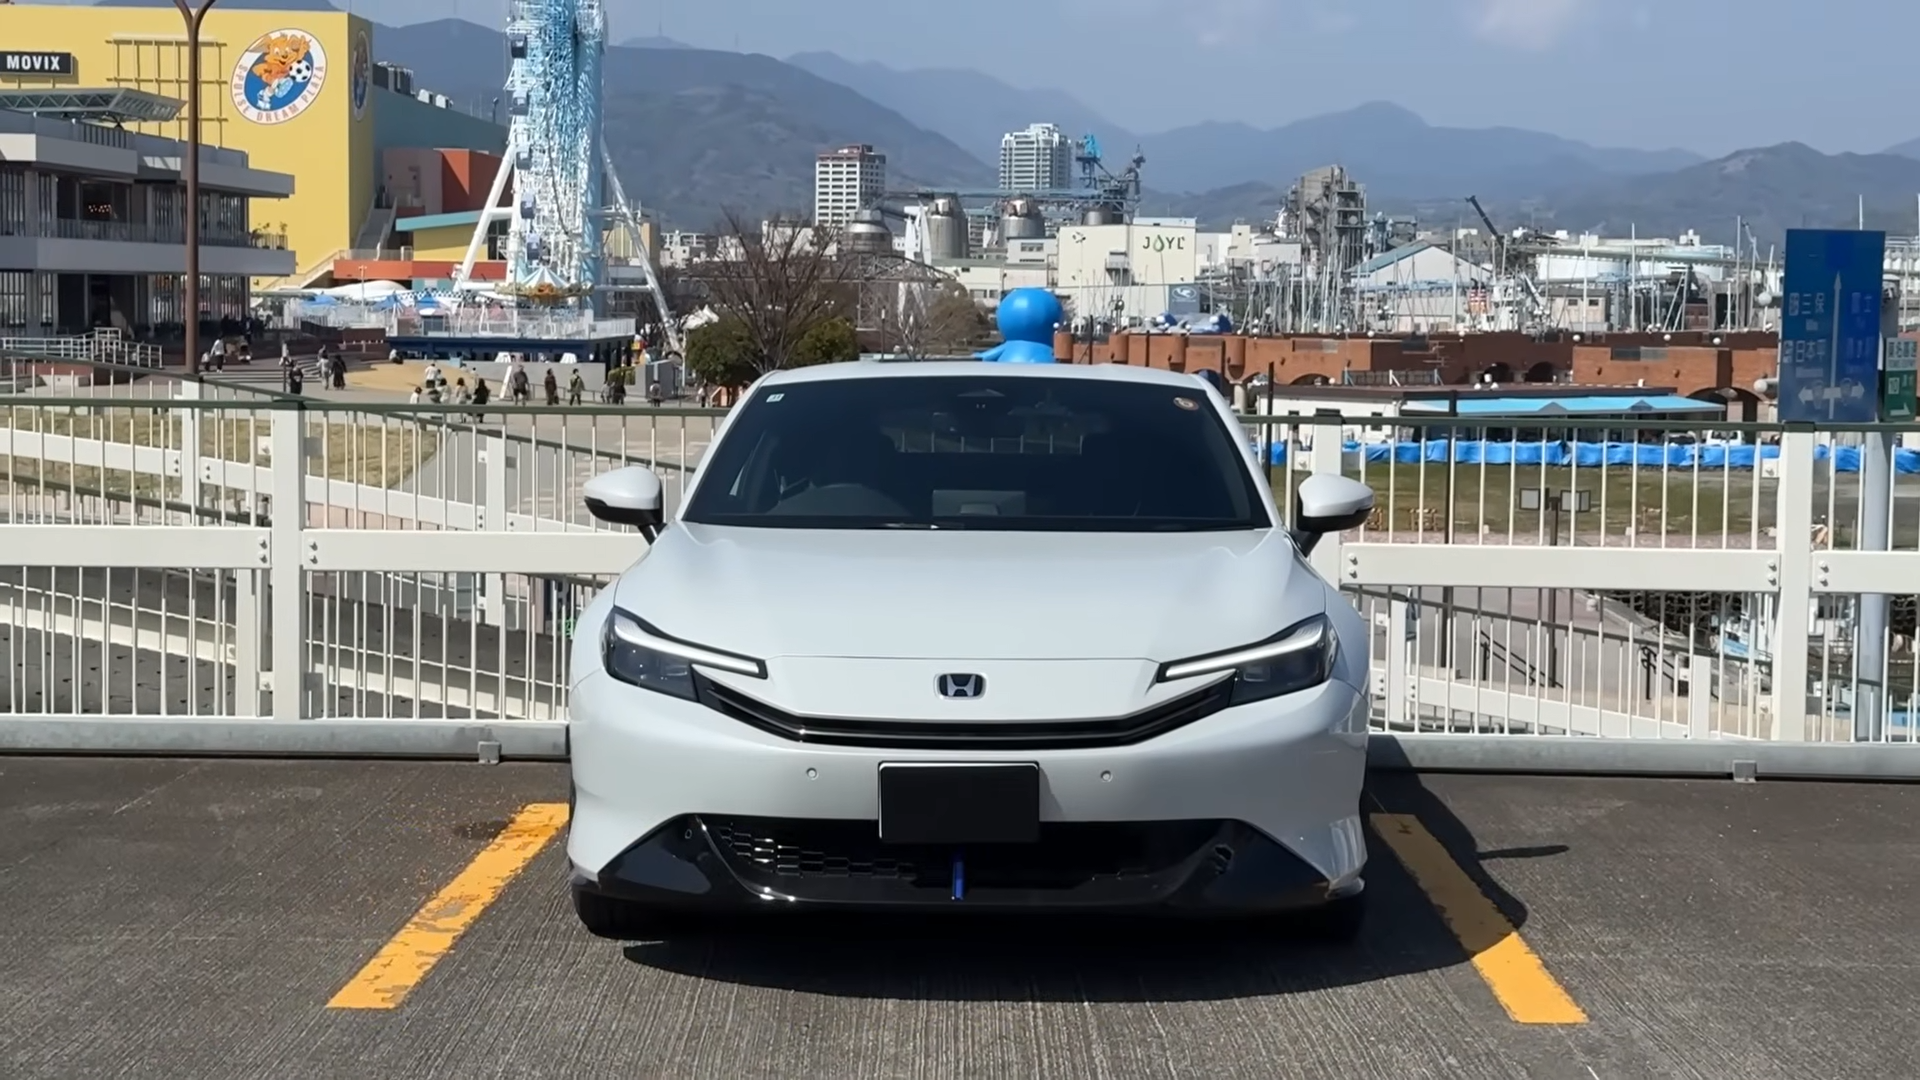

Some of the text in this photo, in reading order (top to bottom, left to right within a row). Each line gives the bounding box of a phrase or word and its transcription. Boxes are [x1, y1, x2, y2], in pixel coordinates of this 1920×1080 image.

[6, 55, 60, 70] MOVIX
[256, 104, 300, 122] DREAM
[301, 65, 325, 103] PLAZA
